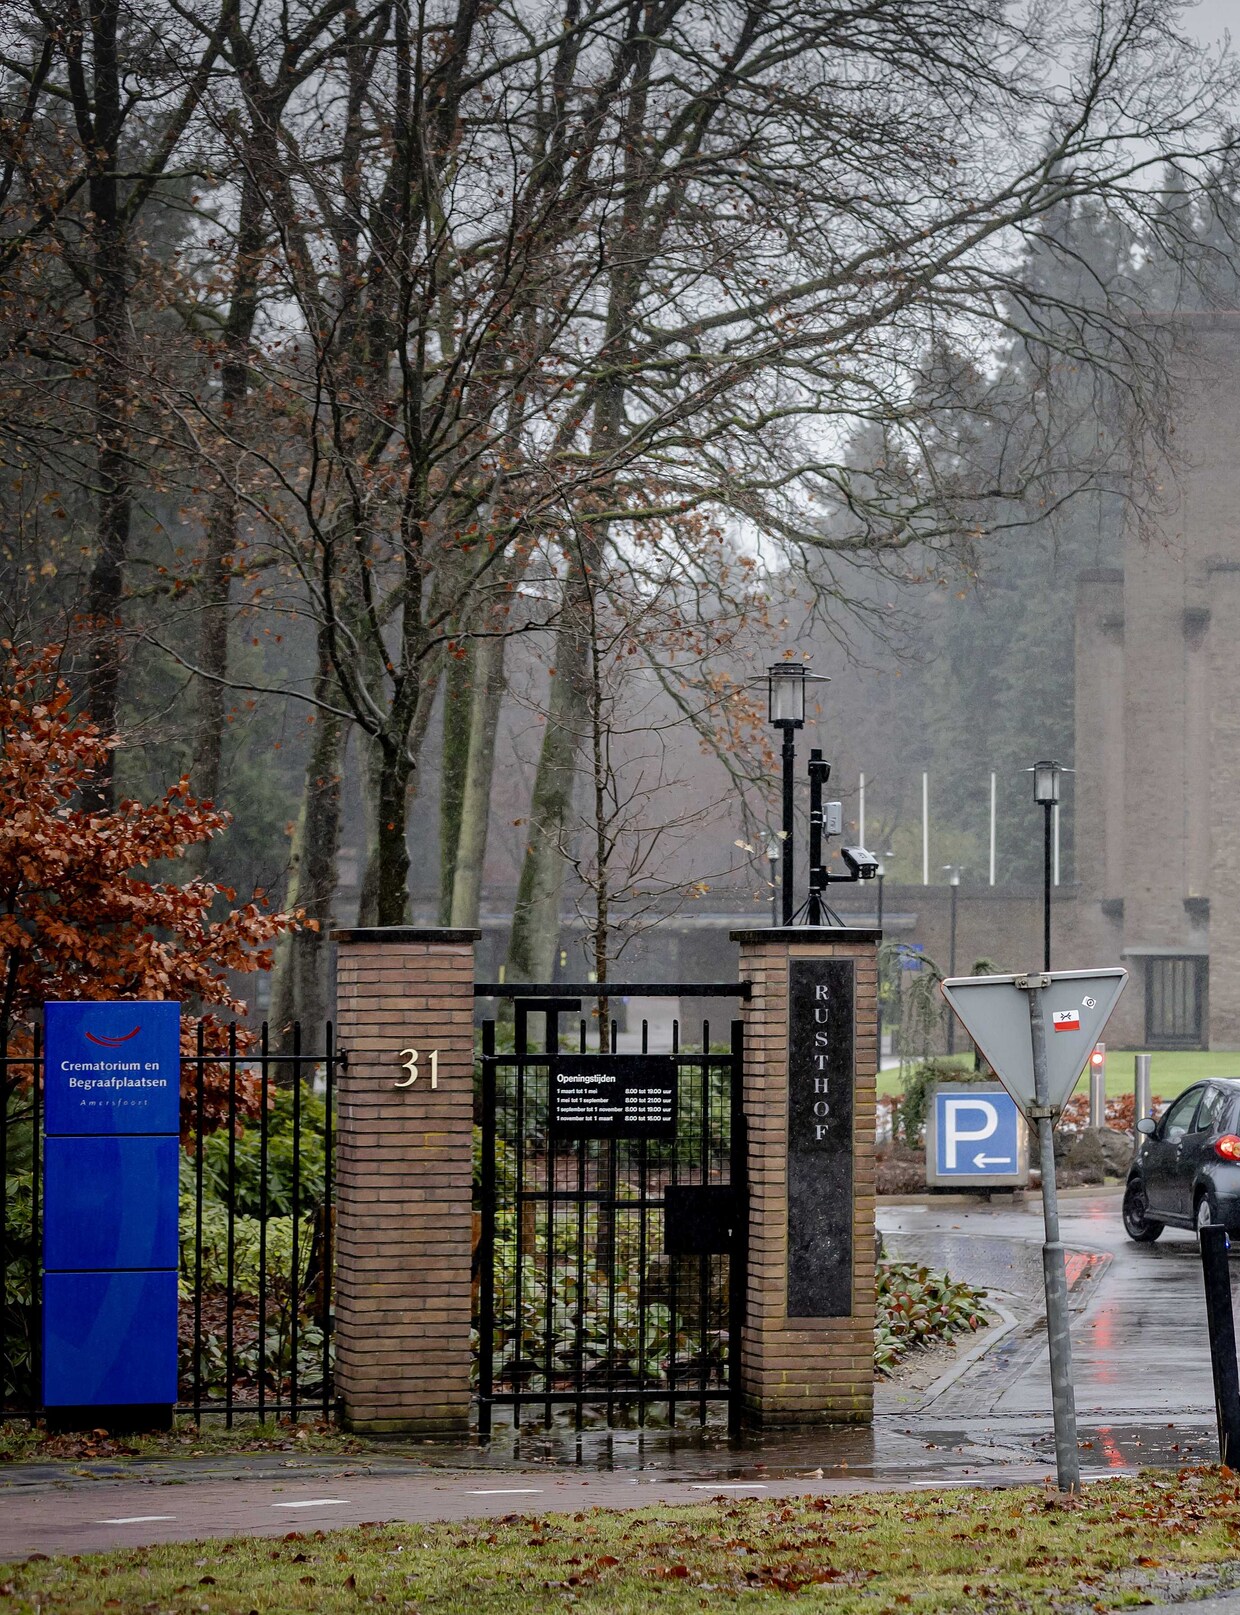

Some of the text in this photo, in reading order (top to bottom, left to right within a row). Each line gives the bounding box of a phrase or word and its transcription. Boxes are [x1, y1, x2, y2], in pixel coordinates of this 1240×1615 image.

[60, 1060, 160, 1071] Crematorium en
[394, 1048, 438, 1089] 31
[813, 984, 830, 1141] RUSTHOF
[69, 1077, 167, 1091] Begraafplaatsen
[556, 1073, 616, 1084] Openingstijden
[945, 1099, 998, 1169] P
